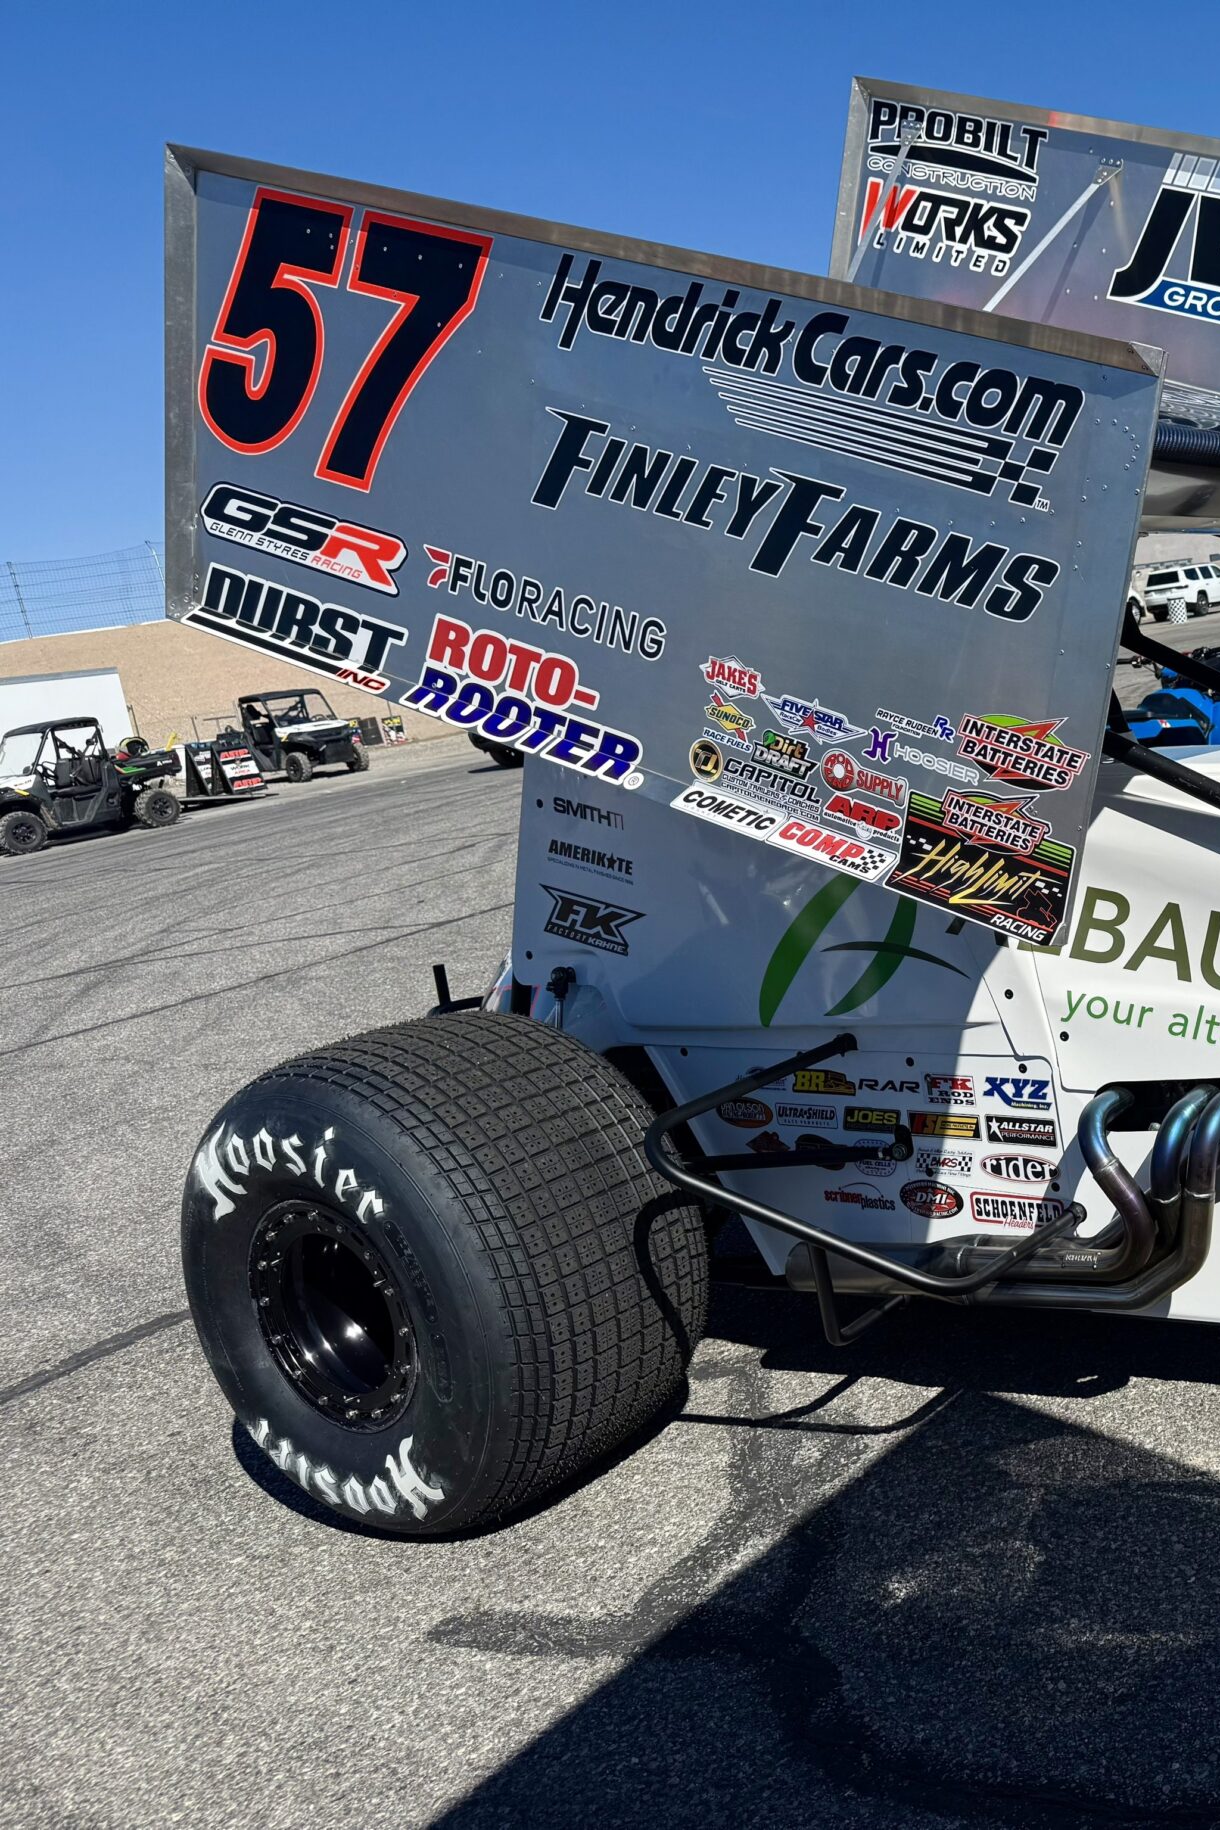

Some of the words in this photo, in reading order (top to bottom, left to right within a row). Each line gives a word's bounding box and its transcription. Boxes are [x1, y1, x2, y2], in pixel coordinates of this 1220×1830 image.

[868, 100, 1048, 172] PROBILT
[867, 156, 1037, 201] CONSTRUCTION
[859, 179, 1030, 254] WORKS
[874, 236, 1009, 276] LIMITED
[198, 186, 494, 493] 57
[540, 253, 1085, 448] HendrickCars.com
[203, 487, 403, 588] GSR
[209, 521, 254, 543] GLENN
[255, 535, 309, 563] STYRES
[310, 553, 363, 580] RACING
[202, 565, 405, 674] DURST
[428, 616, 598, 710] ROTO-
[335, 667, 387, 693] INC
[709, 706, 751, 729] SUNOCO
[781, 699, 811, 717] FIVE
[815, 710, 844, 731] STAR
[876, 709, 904, 725] RAYCE
[905, 719, 938, 736] RUDEEN
[703, 728, 726, 742] RACE
[726, 737, 752, 753] FUELS
[961, 718, 1083, 770] INTERSTATE
[753, 747, 812, 778] DRAFT
[894, 742, 979, 785] HOOSIER
[961, 738, 1070, 786] BATTERIES
[724, 758, 821, 805] CAPITOL
[857, 769, 904, 801] SUPPLY
[682, 790, 777, 831] COMETIC
[825, 794, 901, 831] ARP
[949, 797, 1040, 839] INTERSTATE
[778, 821, 865, 860] COMP
[873, 829, 900, 842] products
[949, 811, 1031, 851] BATTERIES
[829, 854, 872, 874] CAMS
[990, 913, 1048, 942] RACING
[1060, 989, 1154, 1024] your
[858, 1078, 920, 1094] RAR
[930, 1077, 973, 1091] FK
[938, 1090, 974, 1098] ROD
[983, 1076, 1050, 1101] XYZ
[846, 1109, 897, 1125] JOES
[928, 1097, 975, 1106] ENDS
[1000, 1121, 1054, 1133] ALLSTAR
[1001, 1132, 1055, 1141] PERFORMANCE
[198, 1119, 386, 1223] Hoosier
[985, 1156, 1055, 1182] rider
[915, 1191, 948, 1205] DMI
[975, 1197, 1063, 1223] SCHOENFELD
[1003, 1217, 1034, 1230] Headers
